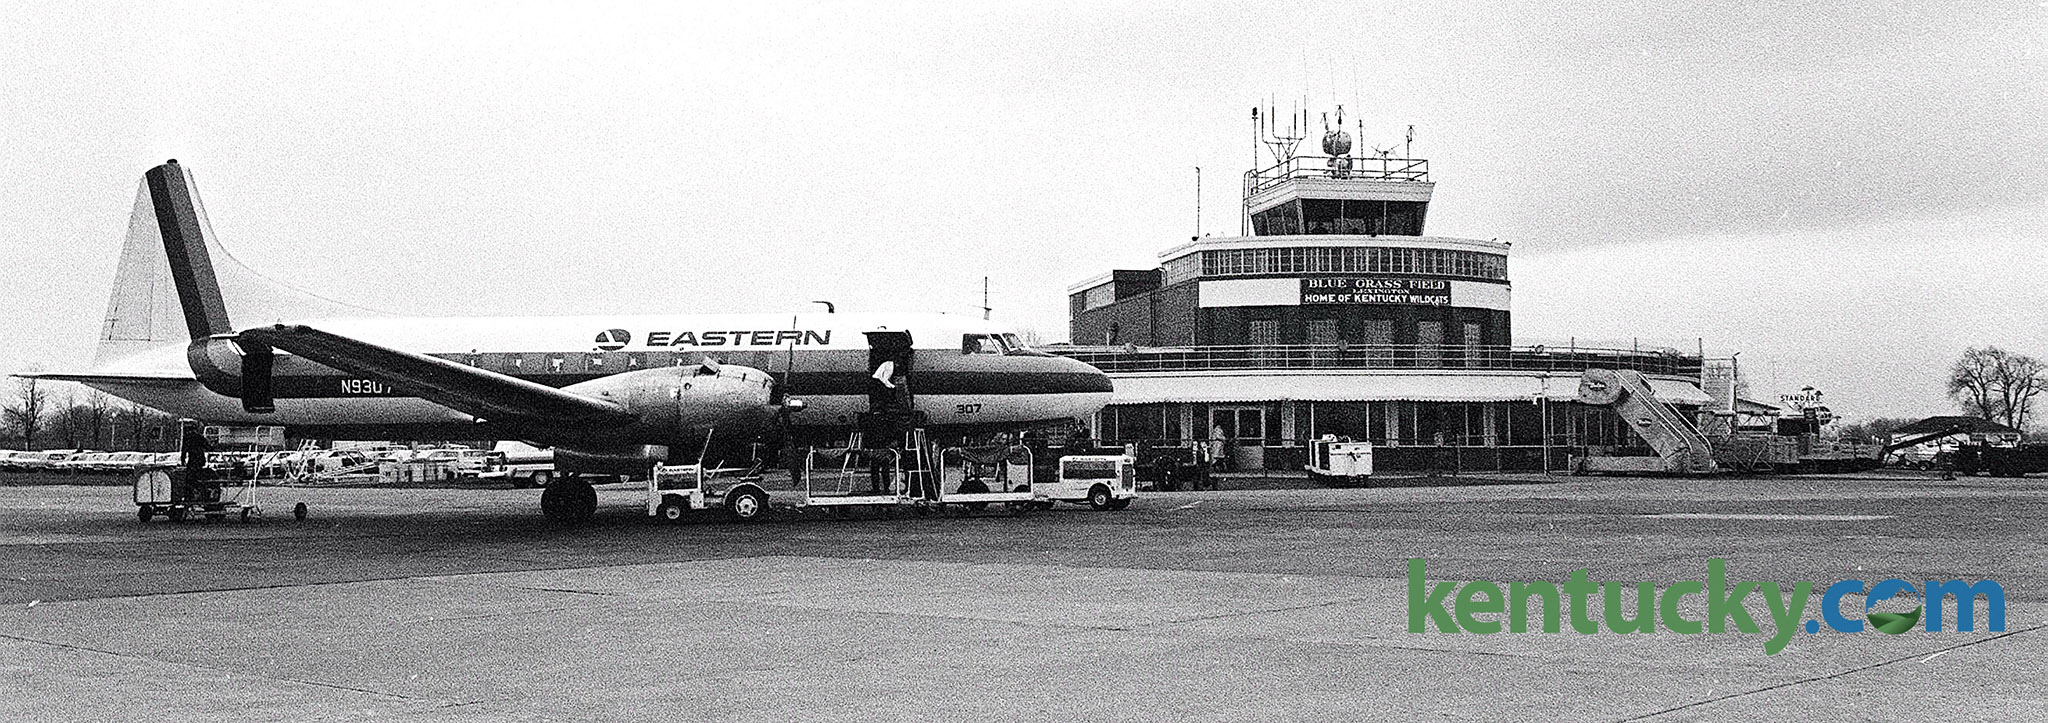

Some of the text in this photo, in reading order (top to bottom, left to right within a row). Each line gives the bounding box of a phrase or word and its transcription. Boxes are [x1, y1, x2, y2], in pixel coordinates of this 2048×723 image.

[1309, 279, 1445, 290] BLUE GRASS FIELD
[1304, 294, 1449, 306] HOME OF KENTUCKY WILDCATS
[646, 330, 832, 347] EASTERN
[956, 403, 982, 414] 307
